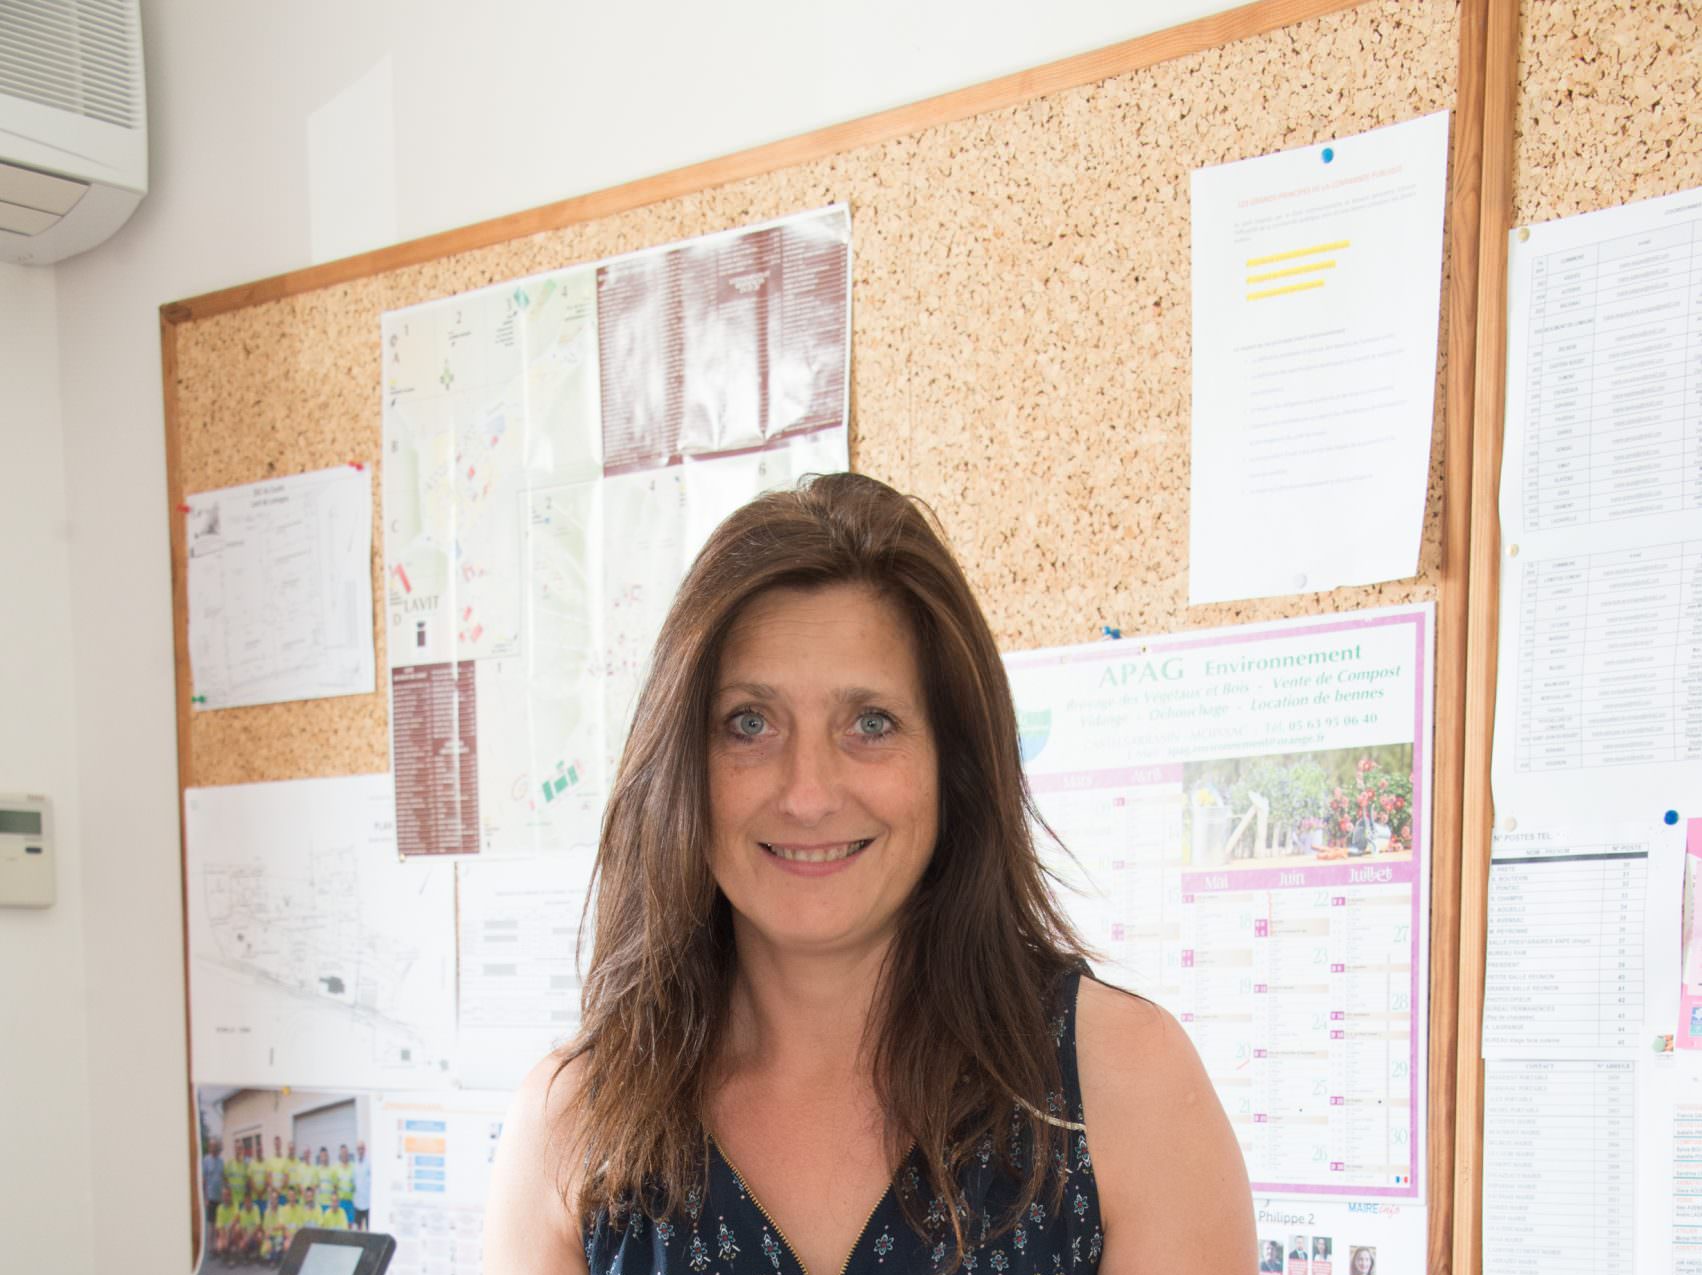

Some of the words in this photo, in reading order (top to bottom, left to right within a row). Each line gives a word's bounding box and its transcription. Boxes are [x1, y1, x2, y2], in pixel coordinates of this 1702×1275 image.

[404, 595, 440, 613] LAVIT
[1099, 656, 1184, 689] APAG
[1204, 644, 1361, 676] Environnement
[1222, 681, 1250, 695] Bois
[1272, 672, 1313, 690] Vente
[1315, 671, 1333, 685] de
[1336, 665, 1402, 684] Compost
[1250, 694, 1309, 712] Location
[1313, 691, 1331, 705] de
[1334, 686, 1385, 703] bennes
[1279, 870, 1306, 887] Juin
[1348, 865, 1393, 883] Juillet
[1258, 1210, 1306, 1226] Philippe
[1307, 1213, 1315, 1225] 2
